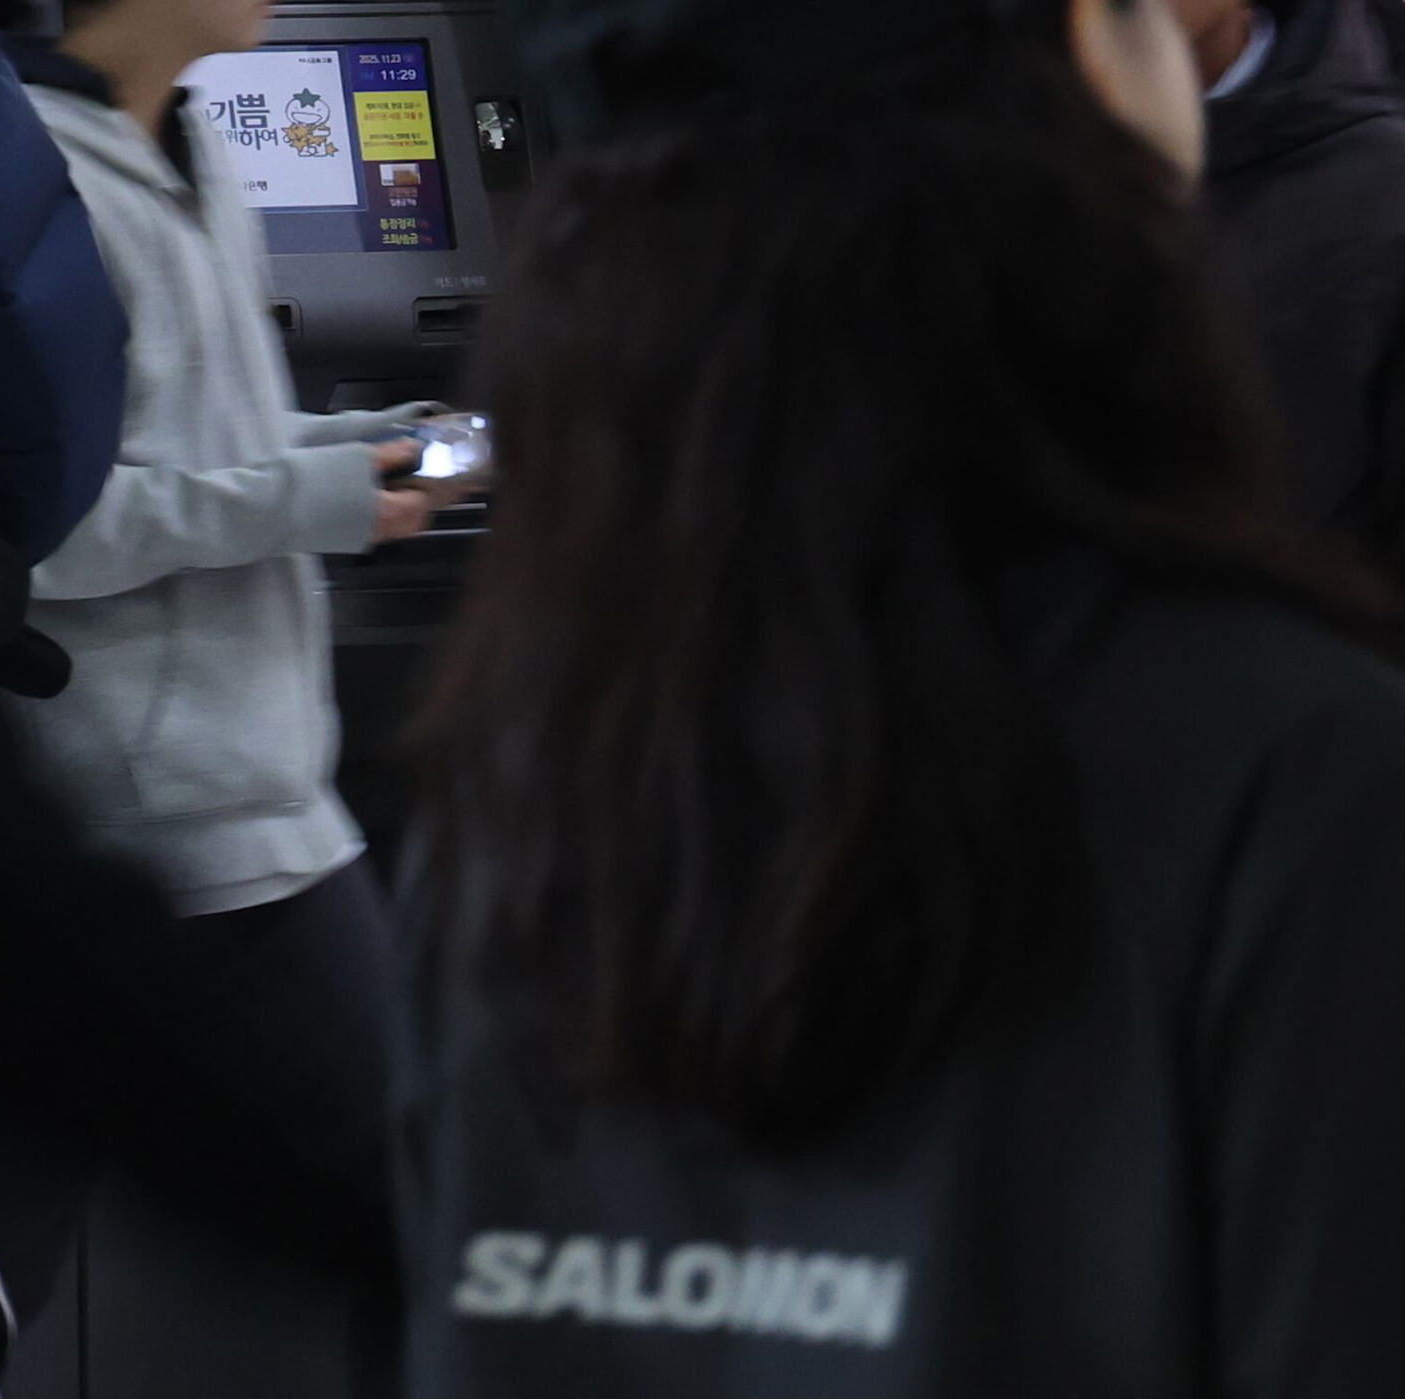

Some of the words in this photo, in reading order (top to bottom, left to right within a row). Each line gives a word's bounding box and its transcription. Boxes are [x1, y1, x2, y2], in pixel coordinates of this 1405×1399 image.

[381, 70, 417, 80] 11:29
[209, 93, 270, 129] 기쁨
[452, 1229, 907, 1349] SALOMON
